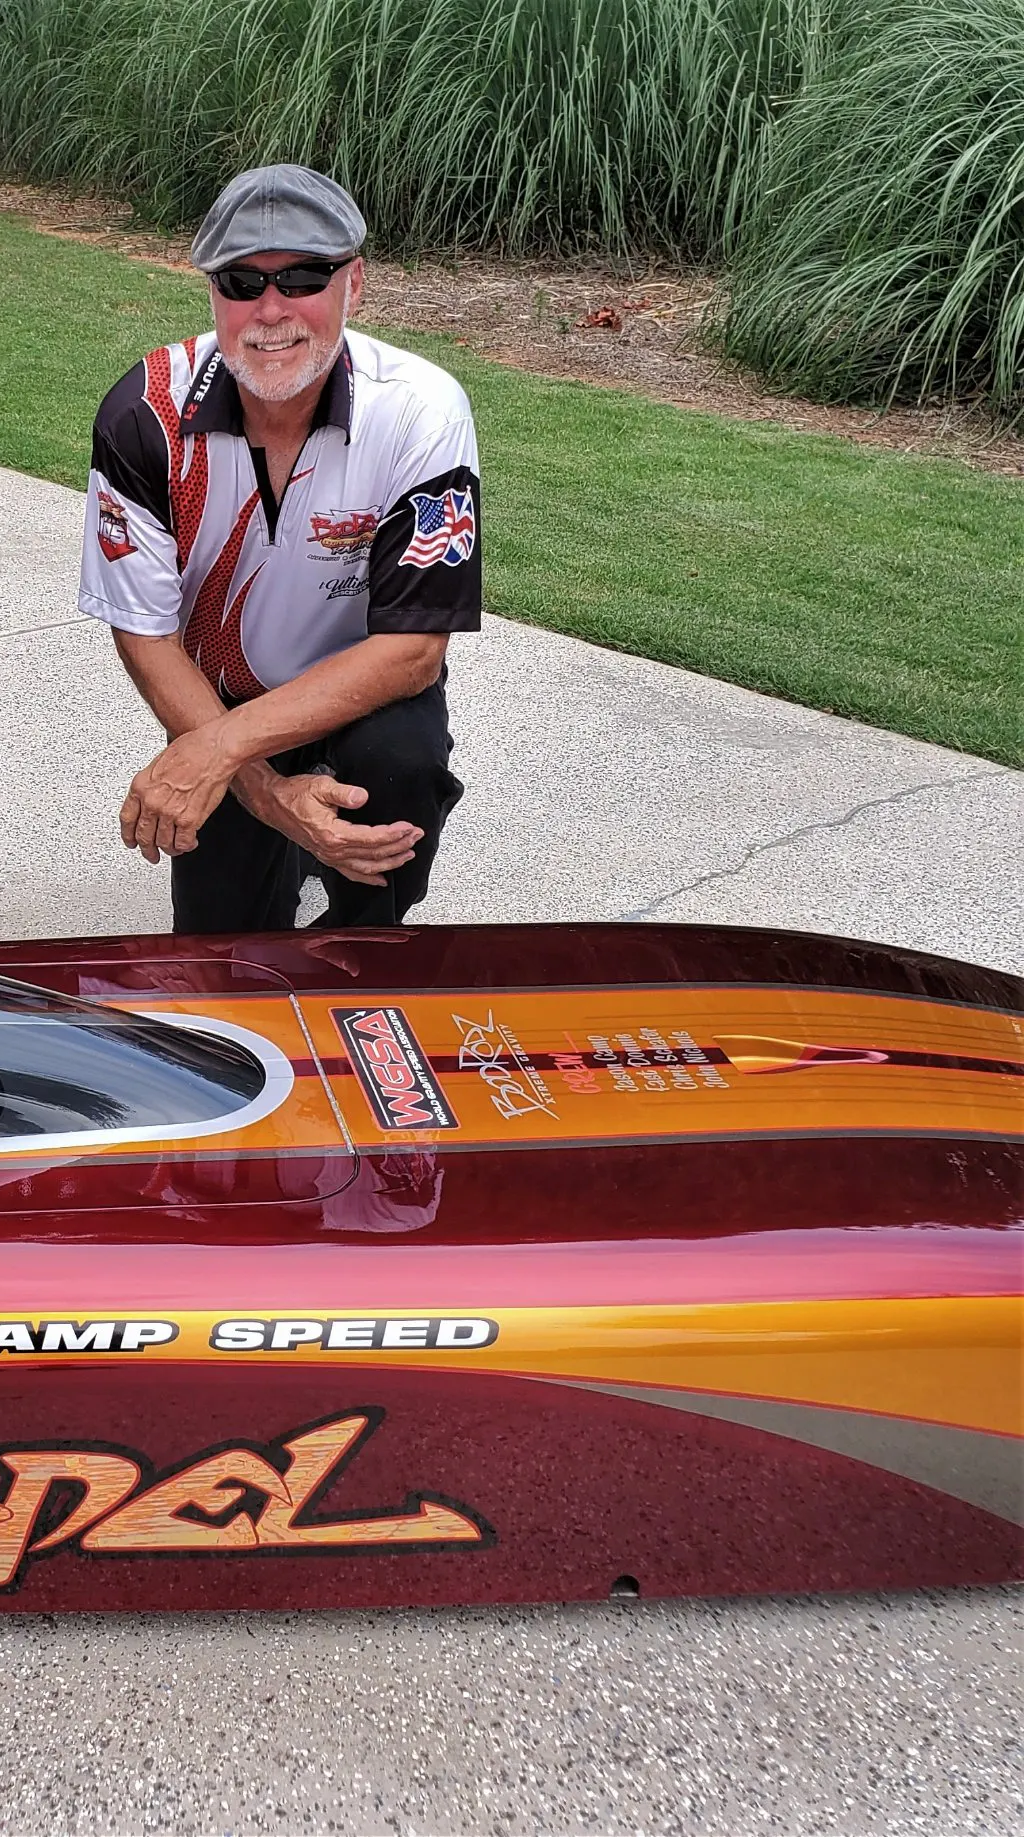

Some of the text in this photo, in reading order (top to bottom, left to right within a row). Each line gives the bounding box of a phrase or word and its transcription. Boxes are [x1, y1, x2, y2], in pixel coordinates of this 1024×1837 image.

[183, 351, 222, 421] ROUTE 21
[352, 1009, 433, 1127] WGSA
[498, 1023, 557, 1104] XTREME GRAVITY
[548, 1052, 602, 1094] CREW
[587, 1035, 640, 1092] Jason Camp
[636, 1069, 670, 1092] Fast
[664, 1064, 699, 1090] Chris
[667, 1030, 731, 1089] John Nichols
[210, 1316, 499, 1352] SPEED
